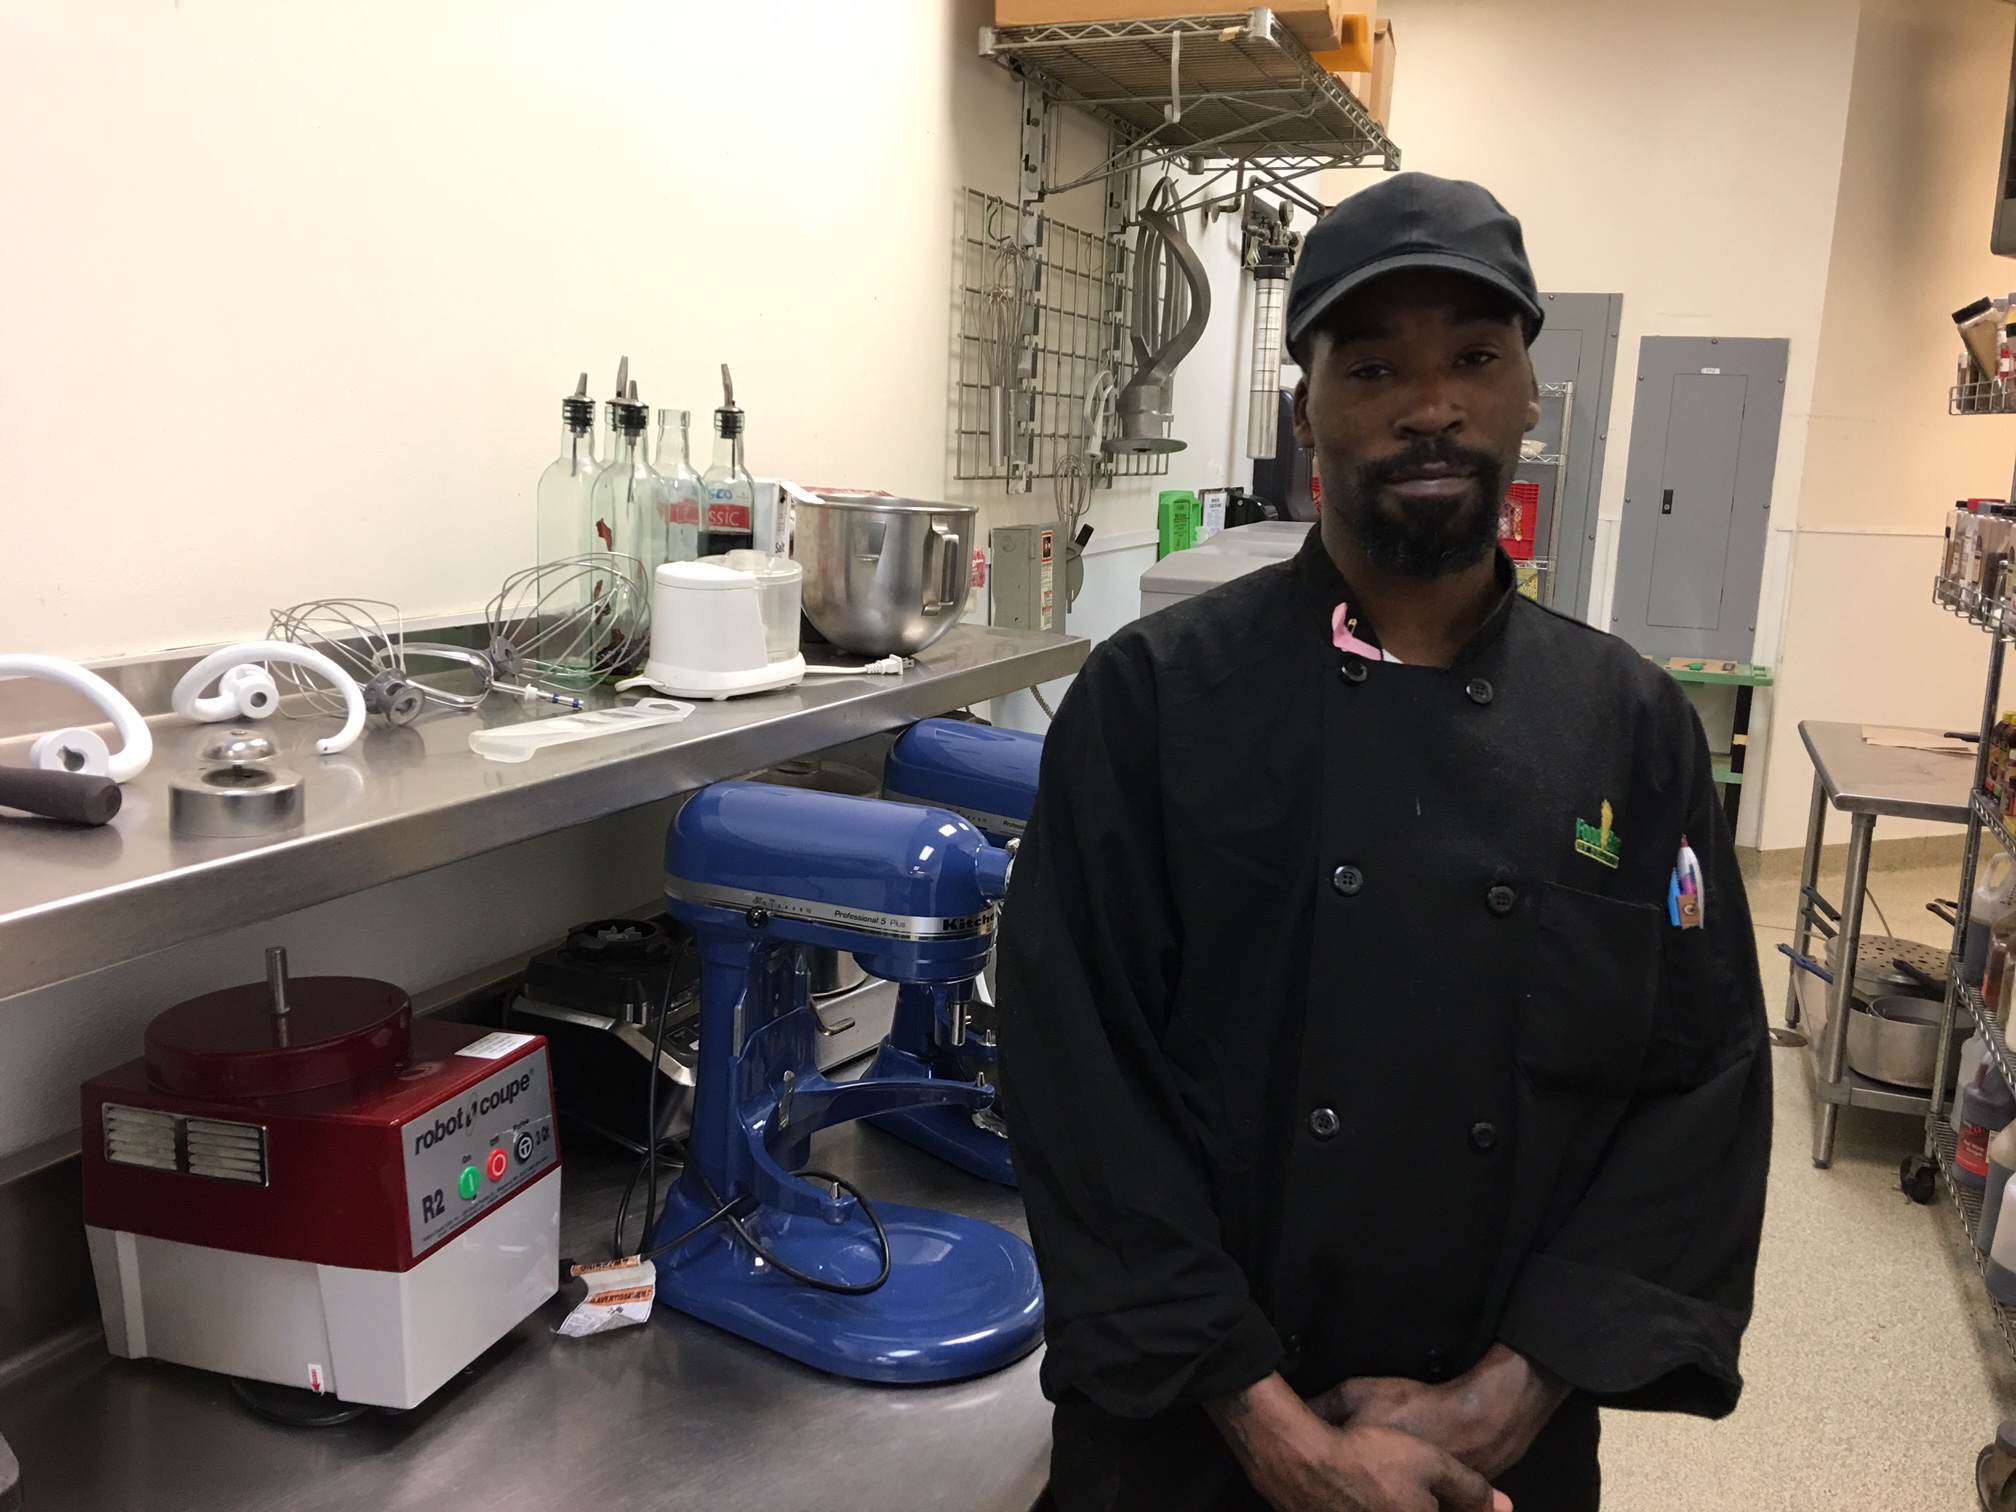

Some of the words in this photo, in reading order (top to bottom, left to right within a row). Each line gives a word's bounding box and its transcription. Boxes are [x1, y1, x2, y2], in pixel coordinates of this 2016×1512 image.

[834, 910, 879, 924] Professional
[880, 917, 887, 925] 5
[889, 918, 906, 928] Plus
[414, 1107, 464, 1156] robot
[480, 1073, 530, 1116] coupe
[462, 1154, 472, 1164] On
[421, 1188, 446, 1224] R2
